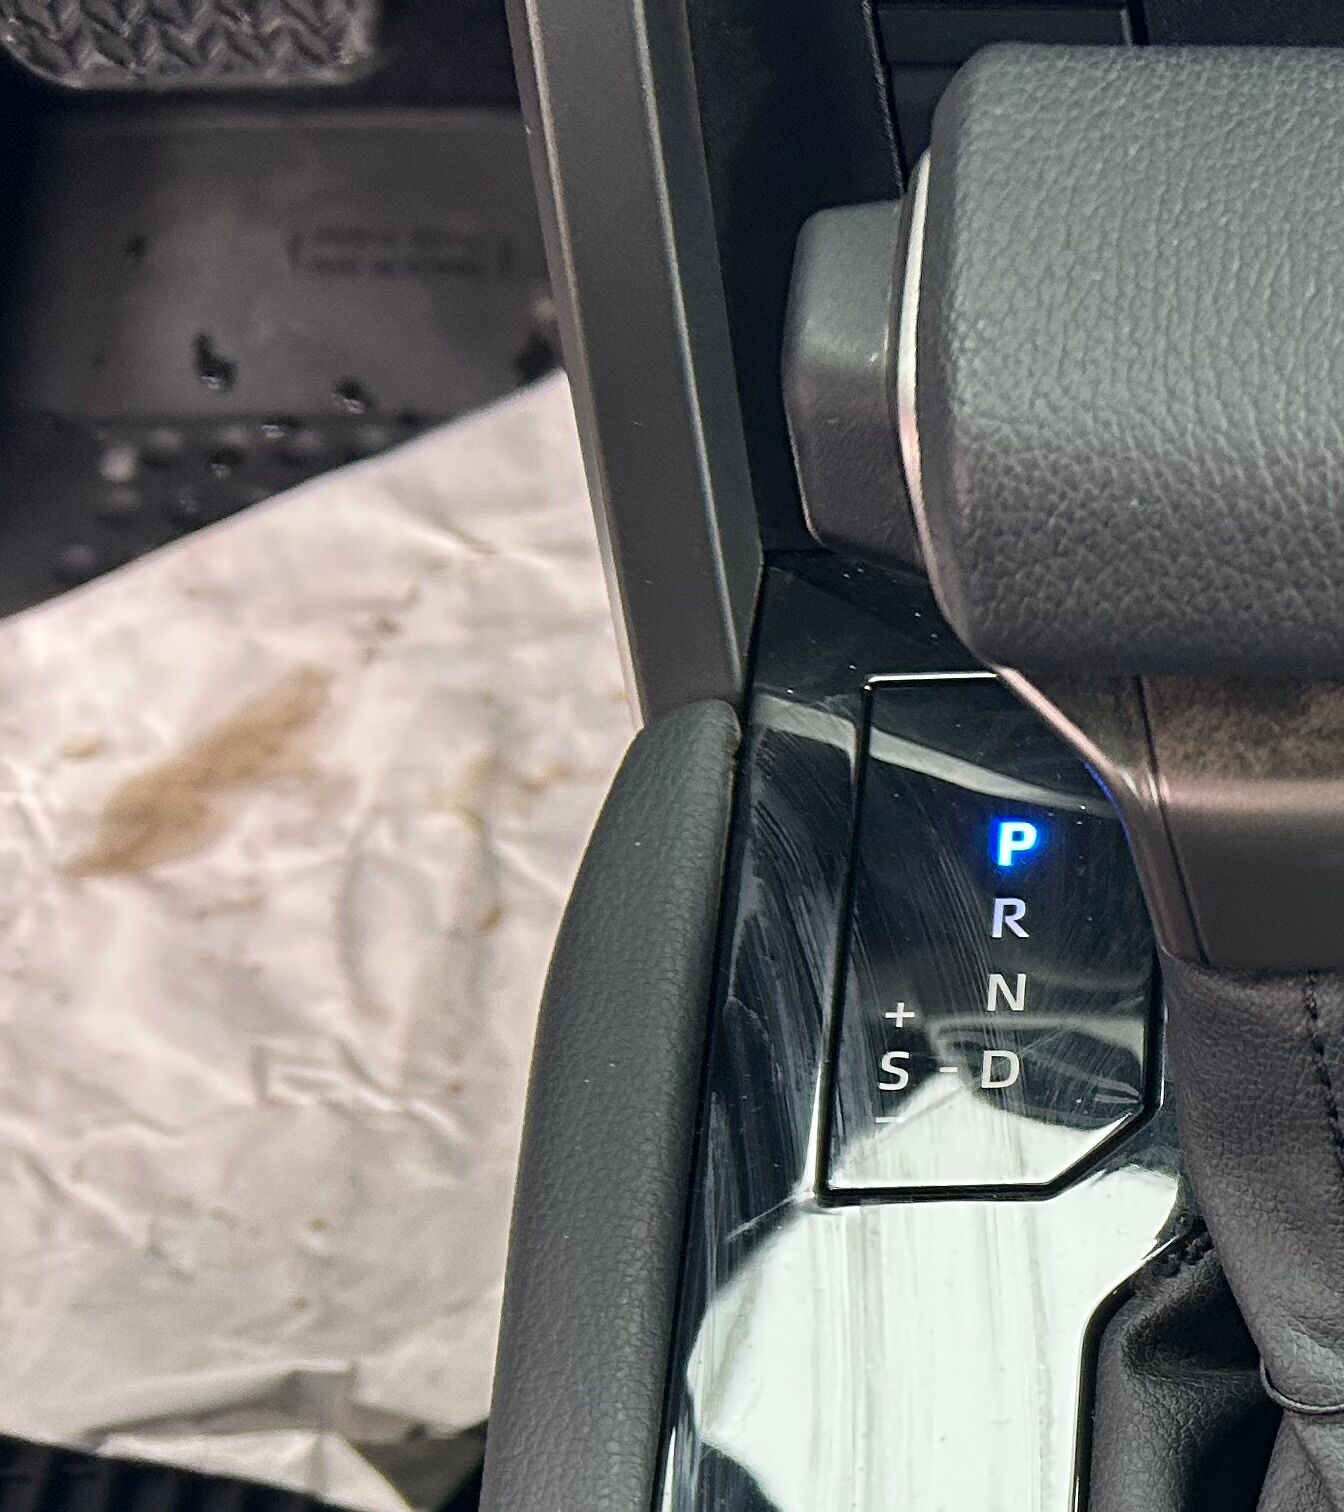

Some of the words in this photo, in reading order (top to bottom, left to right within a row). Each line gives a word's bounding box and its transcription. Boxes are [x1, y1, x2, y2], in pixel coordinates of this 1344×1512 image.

[996, 820, 1038, 866] P
[991, 897, 1029, 938] R
[986, 973, 1027, 1012] N
[877, 1051, 911, 1091] S
[980, 1050, 1020, 1089] D
